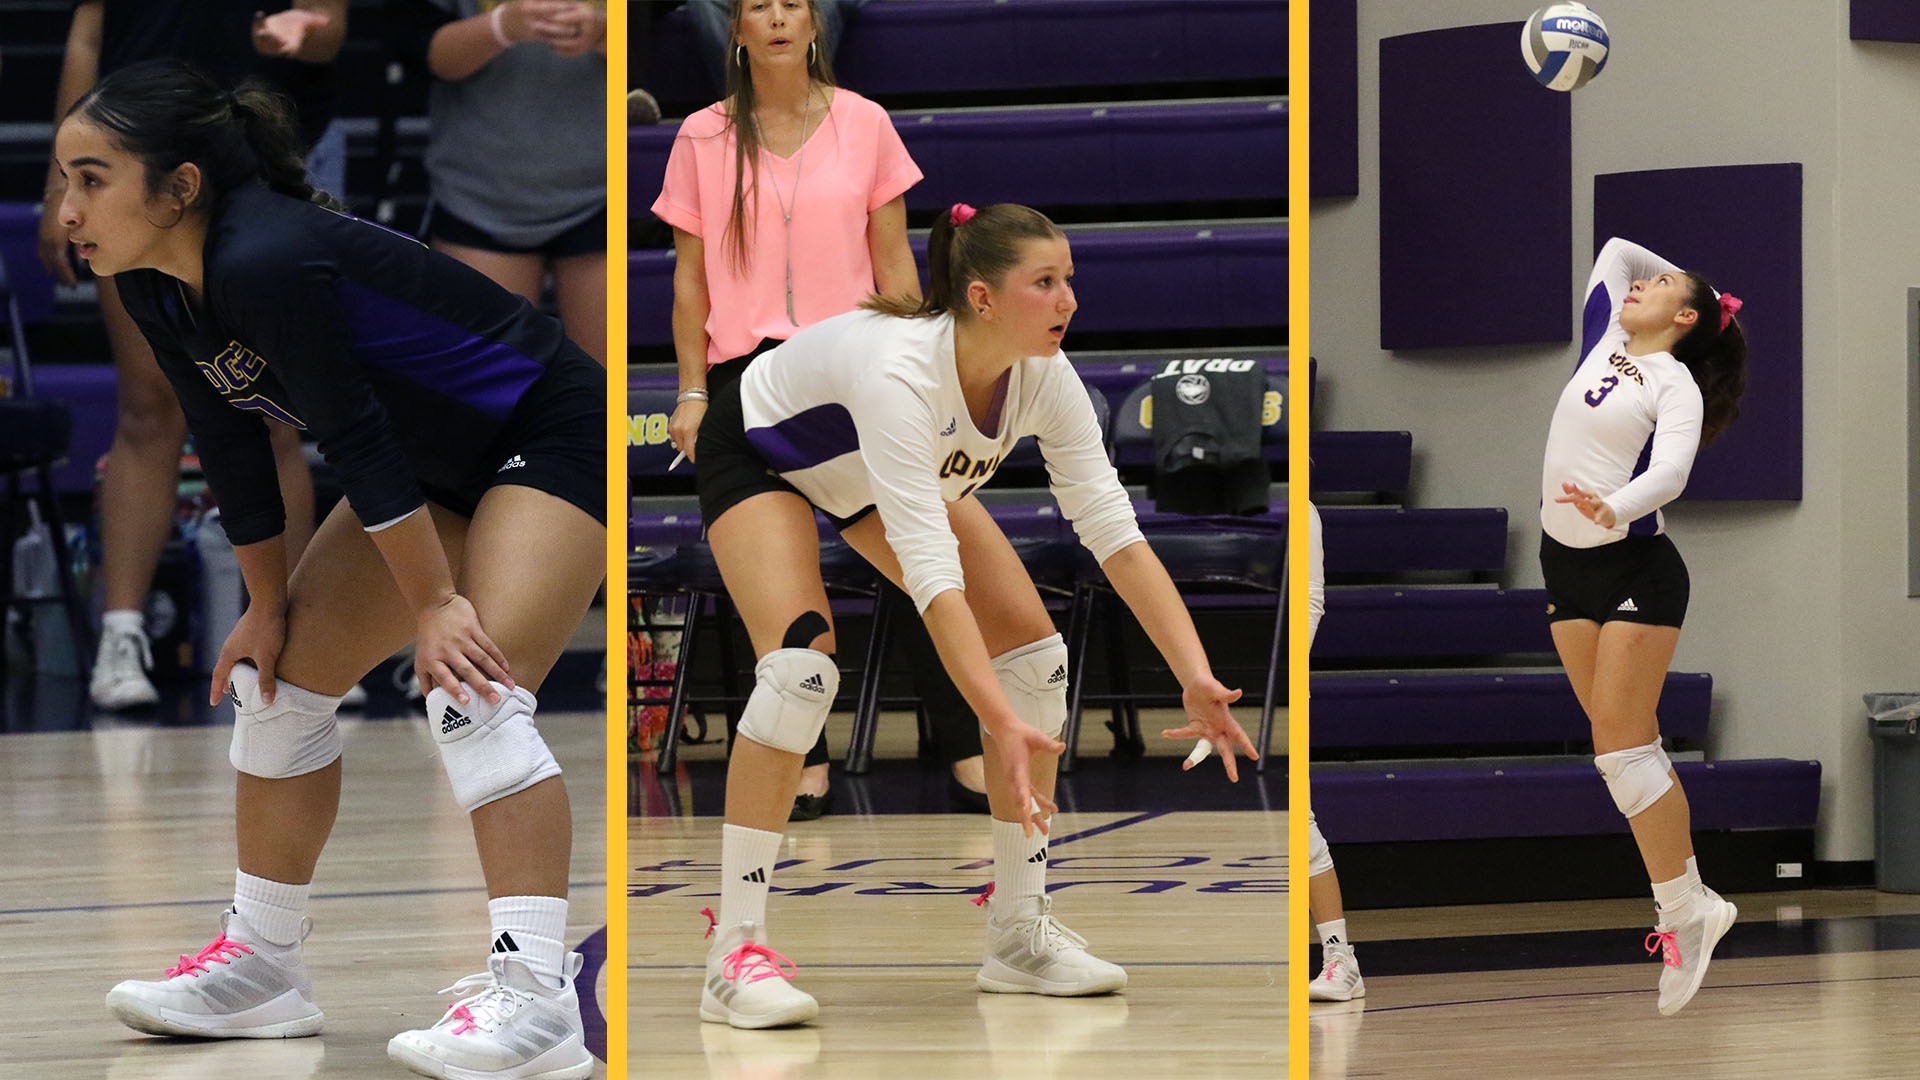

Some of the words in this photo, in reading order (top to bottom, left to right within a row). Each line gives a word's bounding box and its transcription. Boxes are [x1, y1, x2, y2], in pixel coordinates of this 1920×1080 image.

[1585, 375, 1619, 408] 3
[800, 682, 825, 694] adidas
[442, 716, 471, 734] adidas
